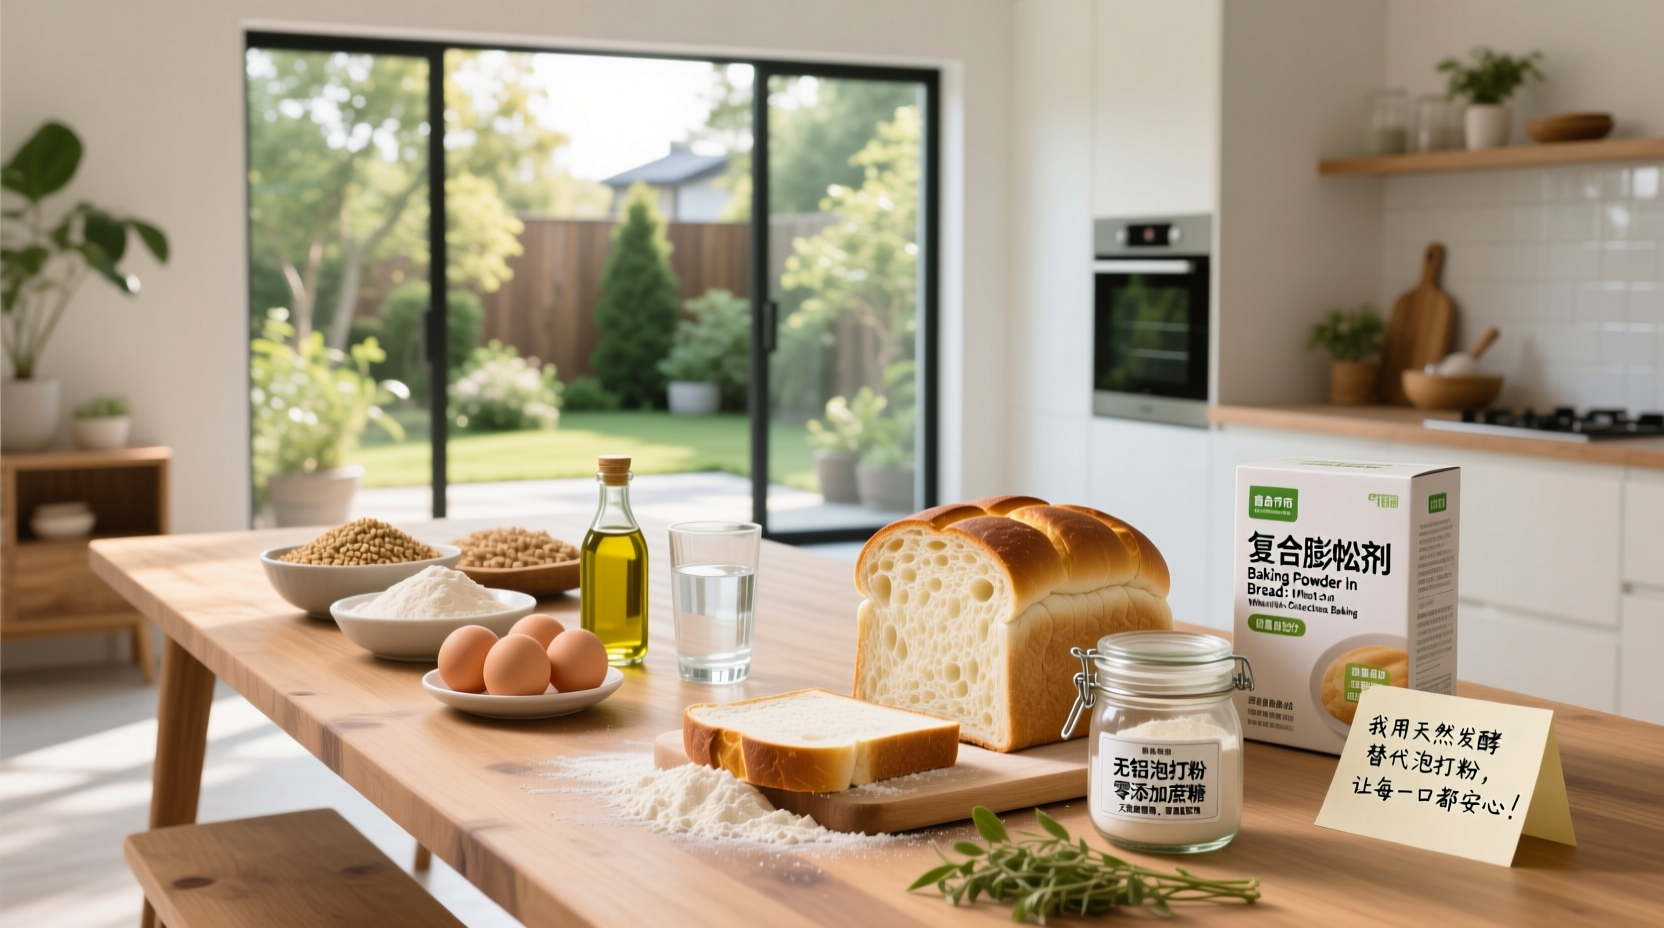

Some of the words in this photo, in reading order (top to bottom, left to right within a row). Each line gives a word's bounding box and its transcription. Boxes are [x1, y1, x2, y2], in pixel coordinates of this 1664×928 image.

[1247, 582, 1289, 598] Bread:
[1248, 567, 1289, 586] Baking
[1293, 572, 1342, 589] Powder
[1368, 714, 1503, 755] 我用天然发酵
[1113, 757, 1207, 780] 无铝泡打粉
[1366, 743, 1489, 785] 替代泡打粉，
[1113, 780, 1206, 804] 零添加蔗糖
[1352, 776, 1521, 820] 让每一口都安心！
